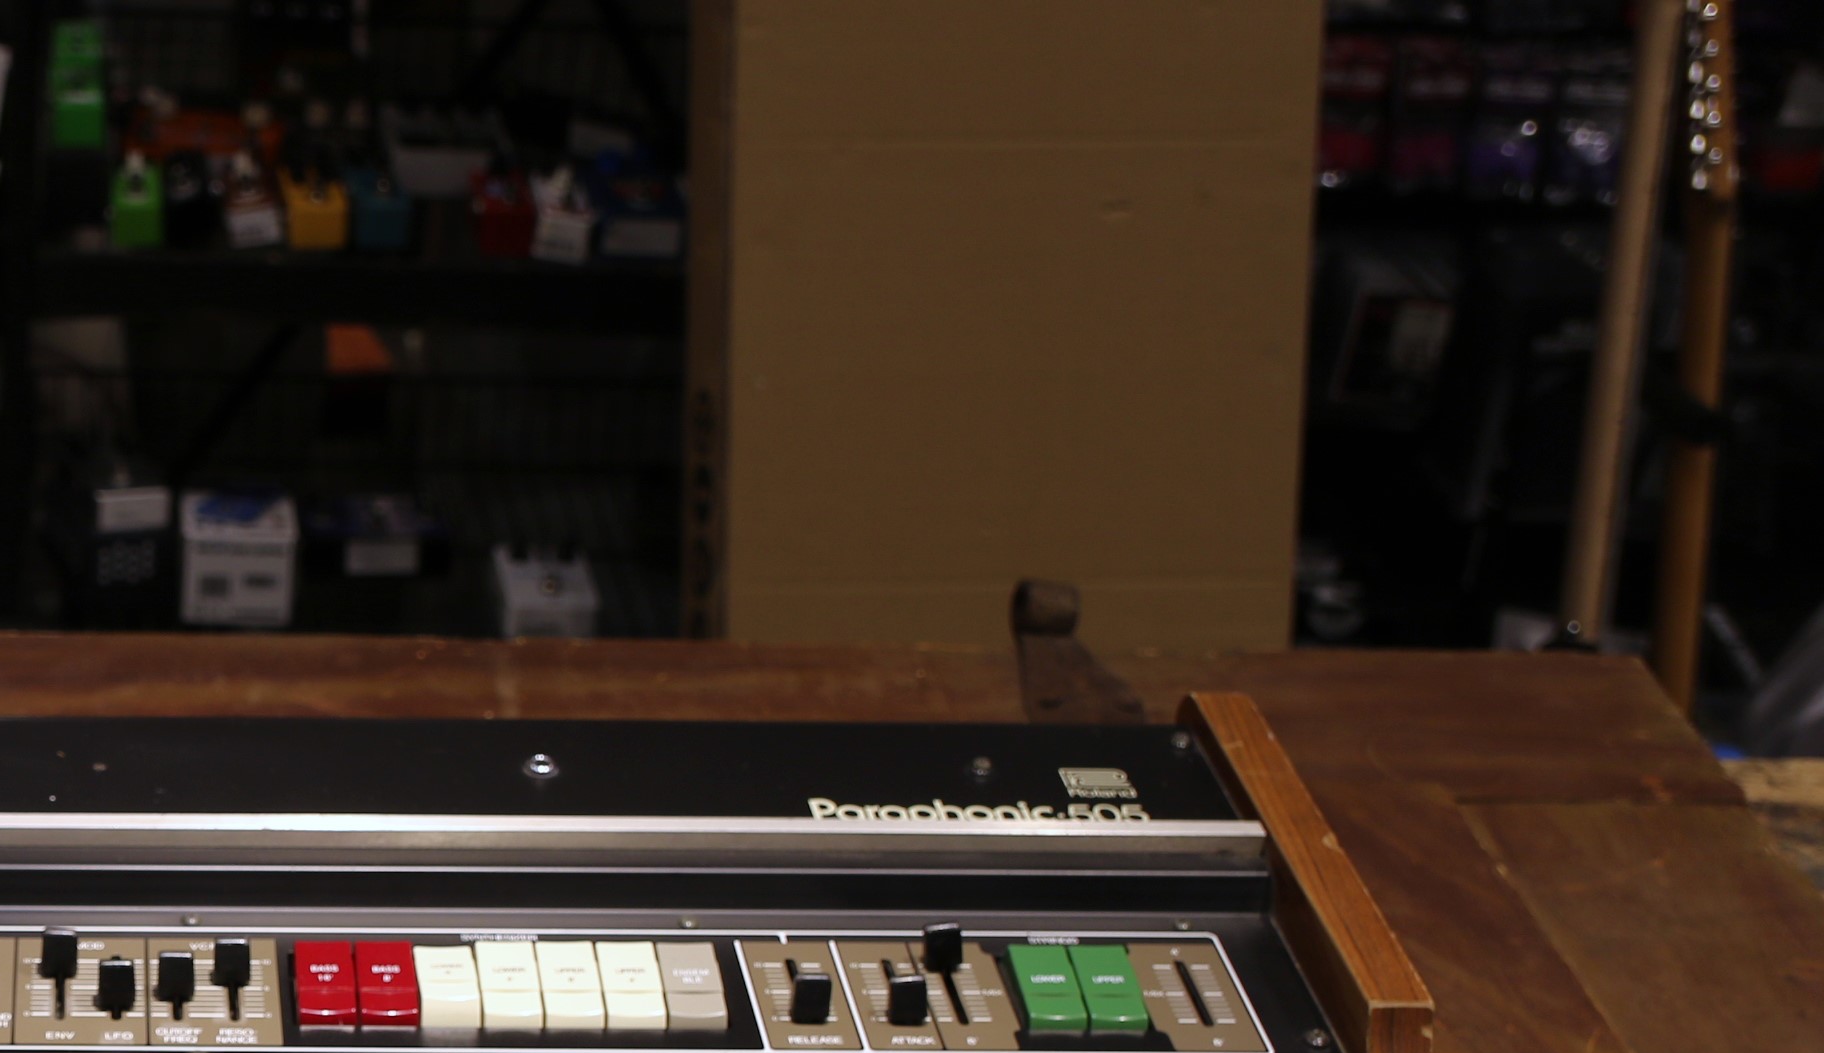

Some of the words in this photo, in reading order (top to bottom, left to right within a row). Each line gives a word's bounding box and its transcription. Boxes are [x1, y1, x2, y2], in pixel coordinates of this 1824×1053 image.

[45, 1030, 77, 1041] ENV
[103, 1030, 135, 1041] LFO
[787, 1034, 845, 1046] RELEASE
[890, 1035, 937, 1046] ATTACK
